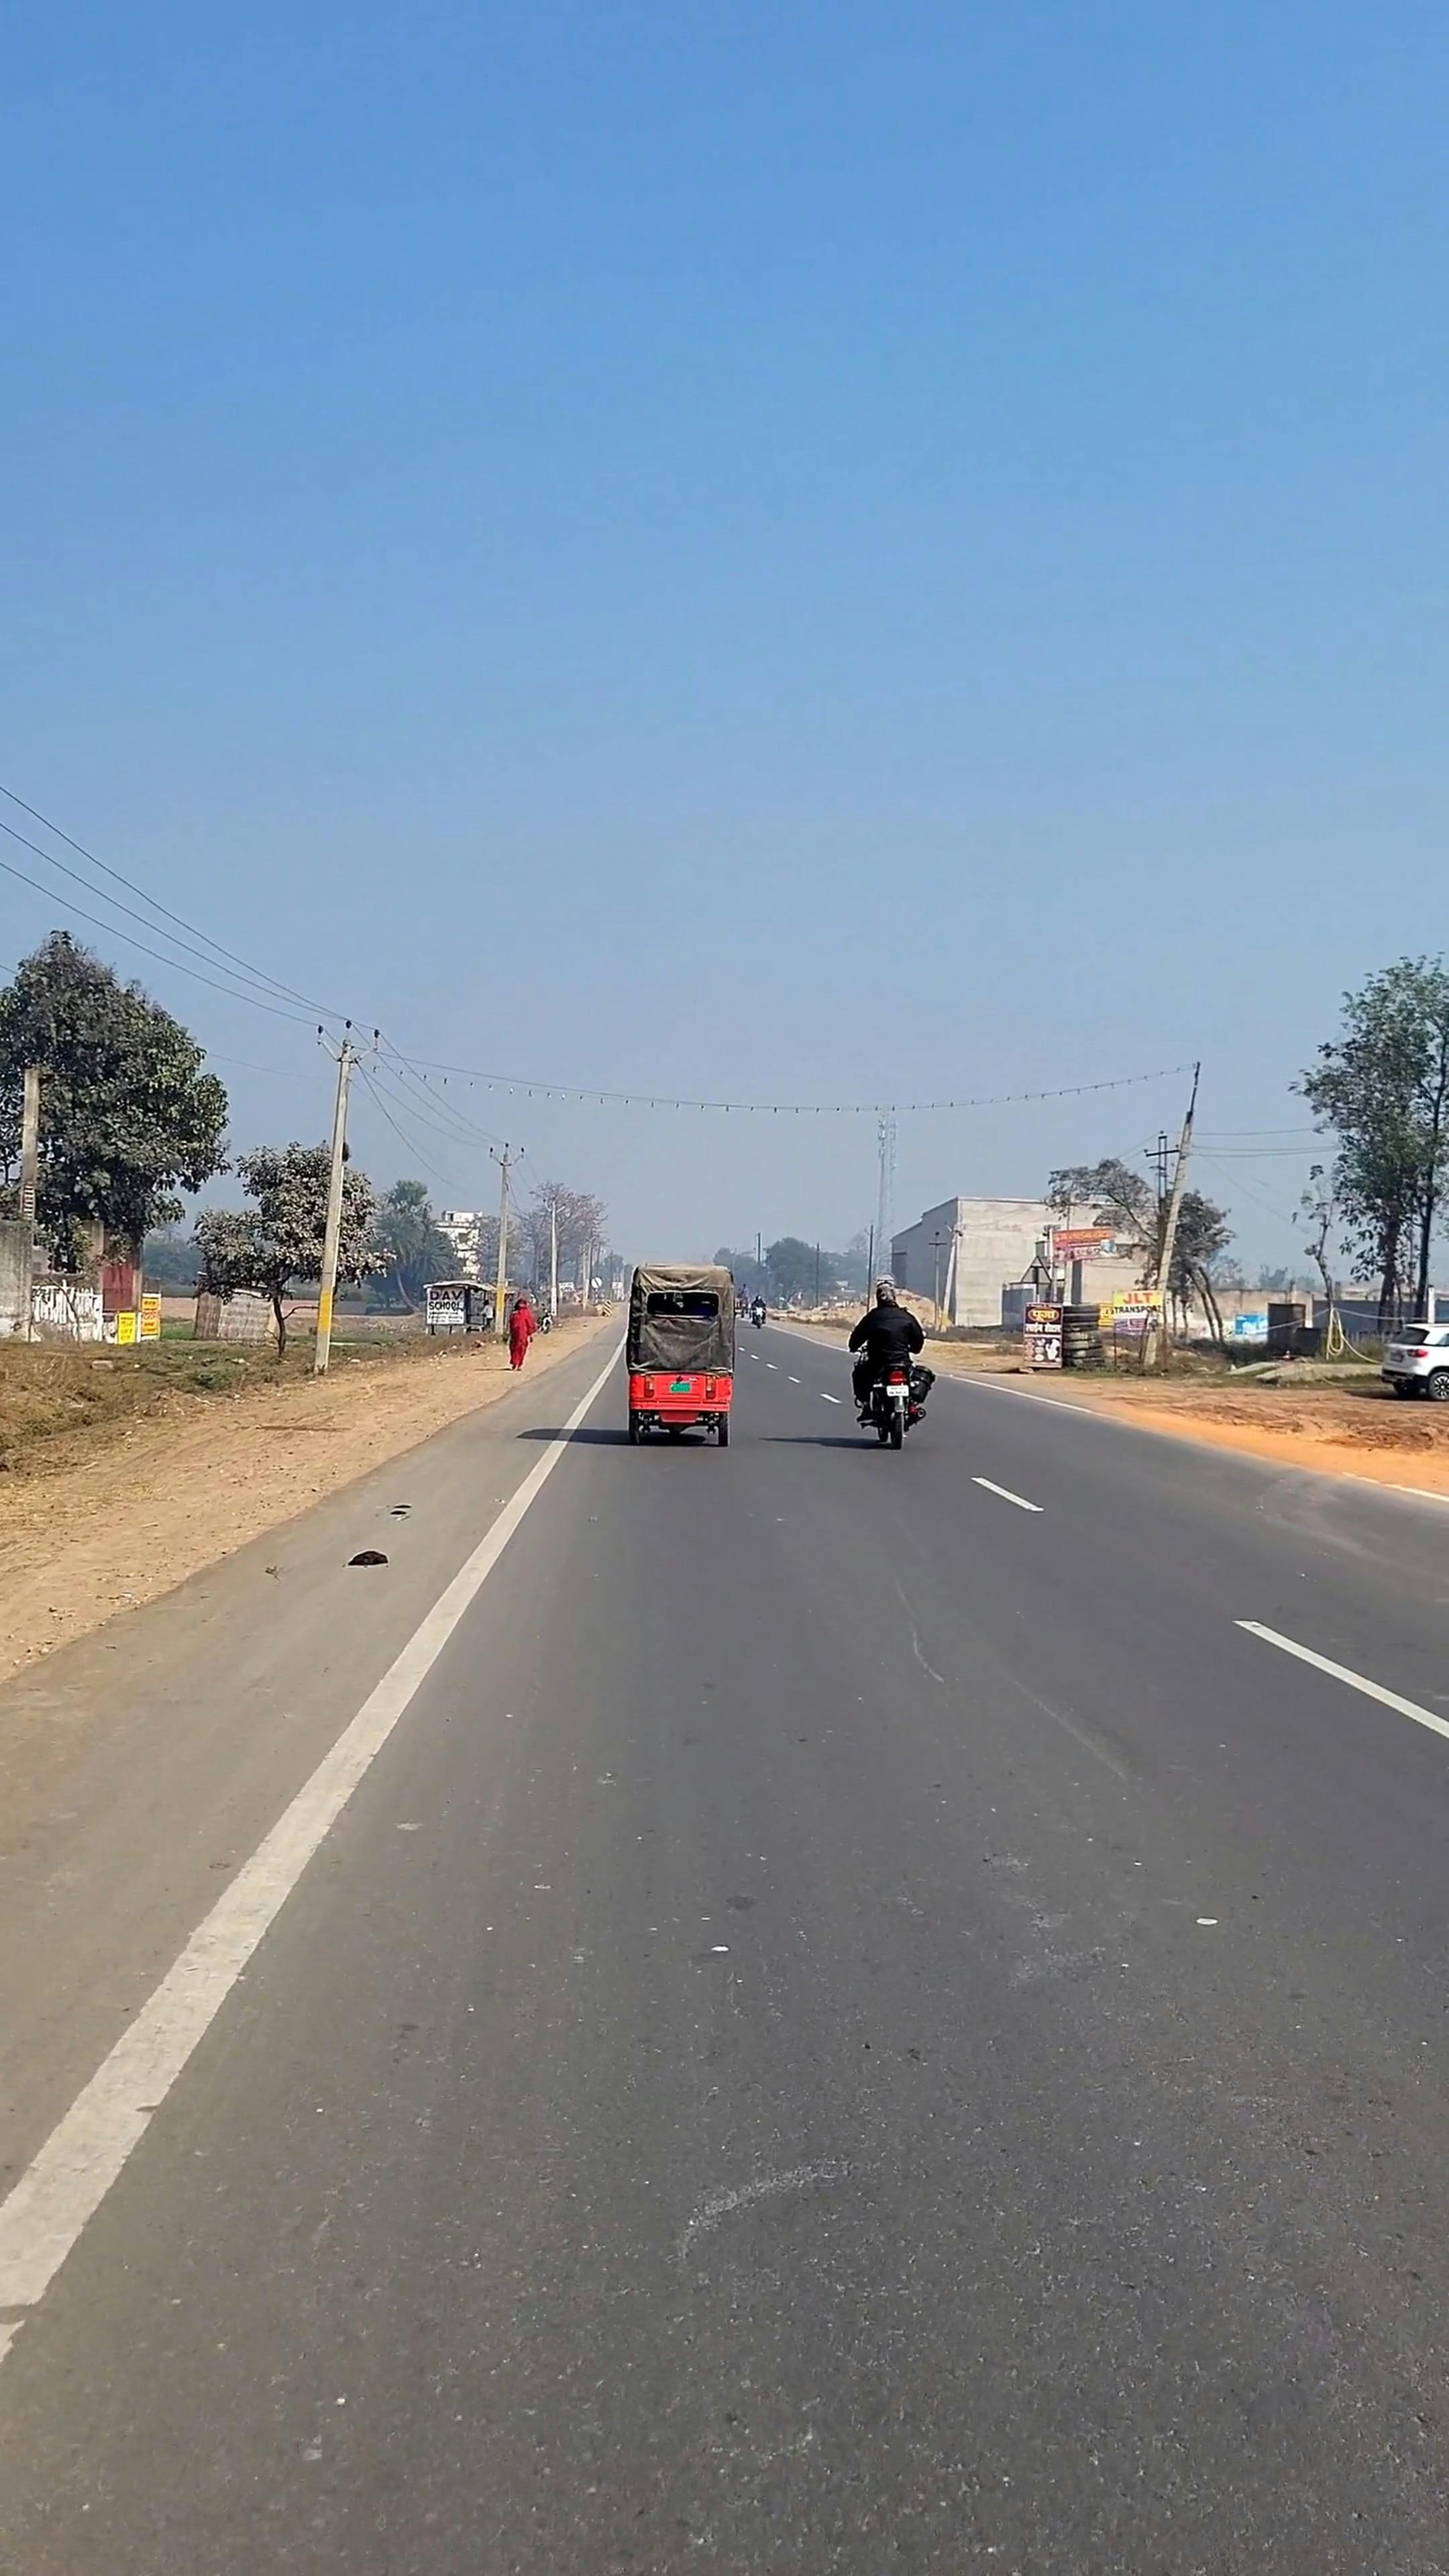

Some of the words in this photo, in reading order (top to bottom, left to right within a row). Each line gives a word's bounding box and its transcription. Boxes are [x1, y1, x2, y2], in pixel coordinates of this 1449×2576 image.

[1124, 1293, 1152, 1303] JLT
[429, 1301, 464, 1311] SCHOOL
[1114, 1305, 1161, 1313] TRANSPORT
